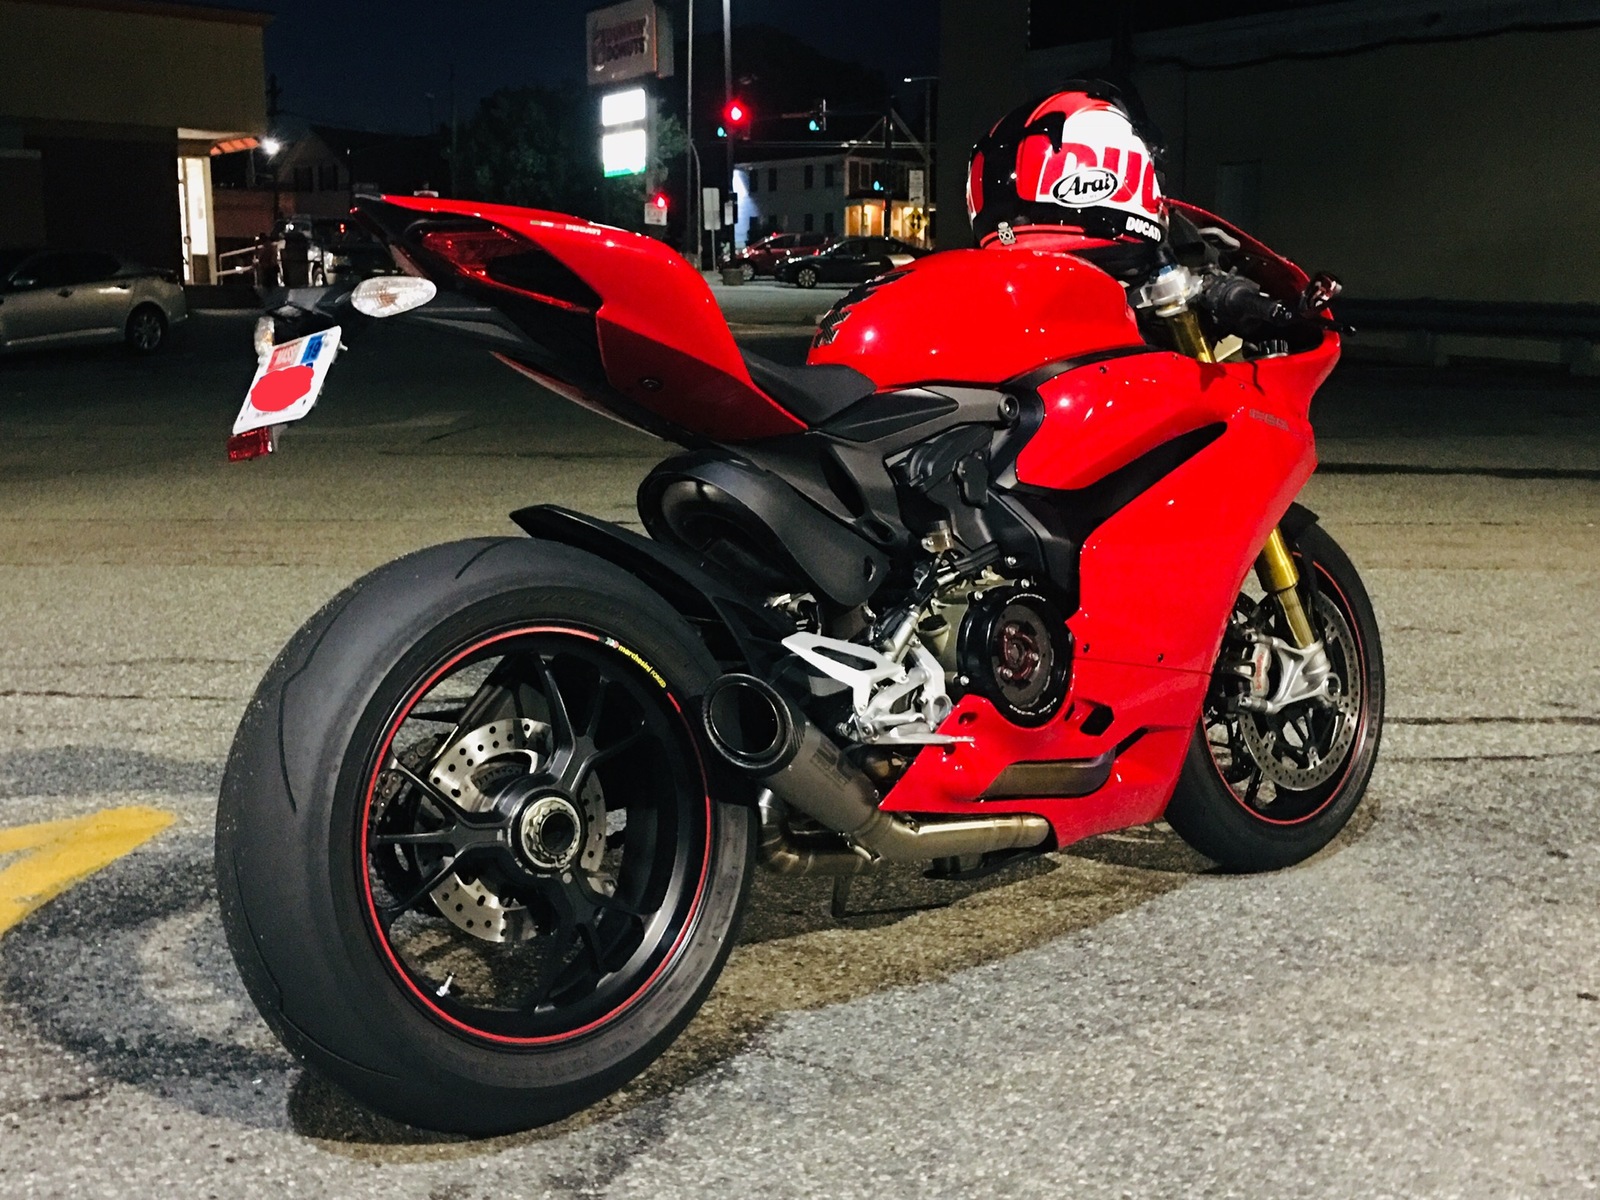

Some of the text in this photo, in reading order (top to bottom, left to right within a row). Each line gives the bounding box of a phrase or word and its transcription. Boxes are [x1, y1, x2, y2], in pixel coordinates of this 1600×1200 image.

[1059, 173, 1110, 198] Arai
[565, 224, 601, 236] DUCATI
[306, 341, 322, 360] 19
